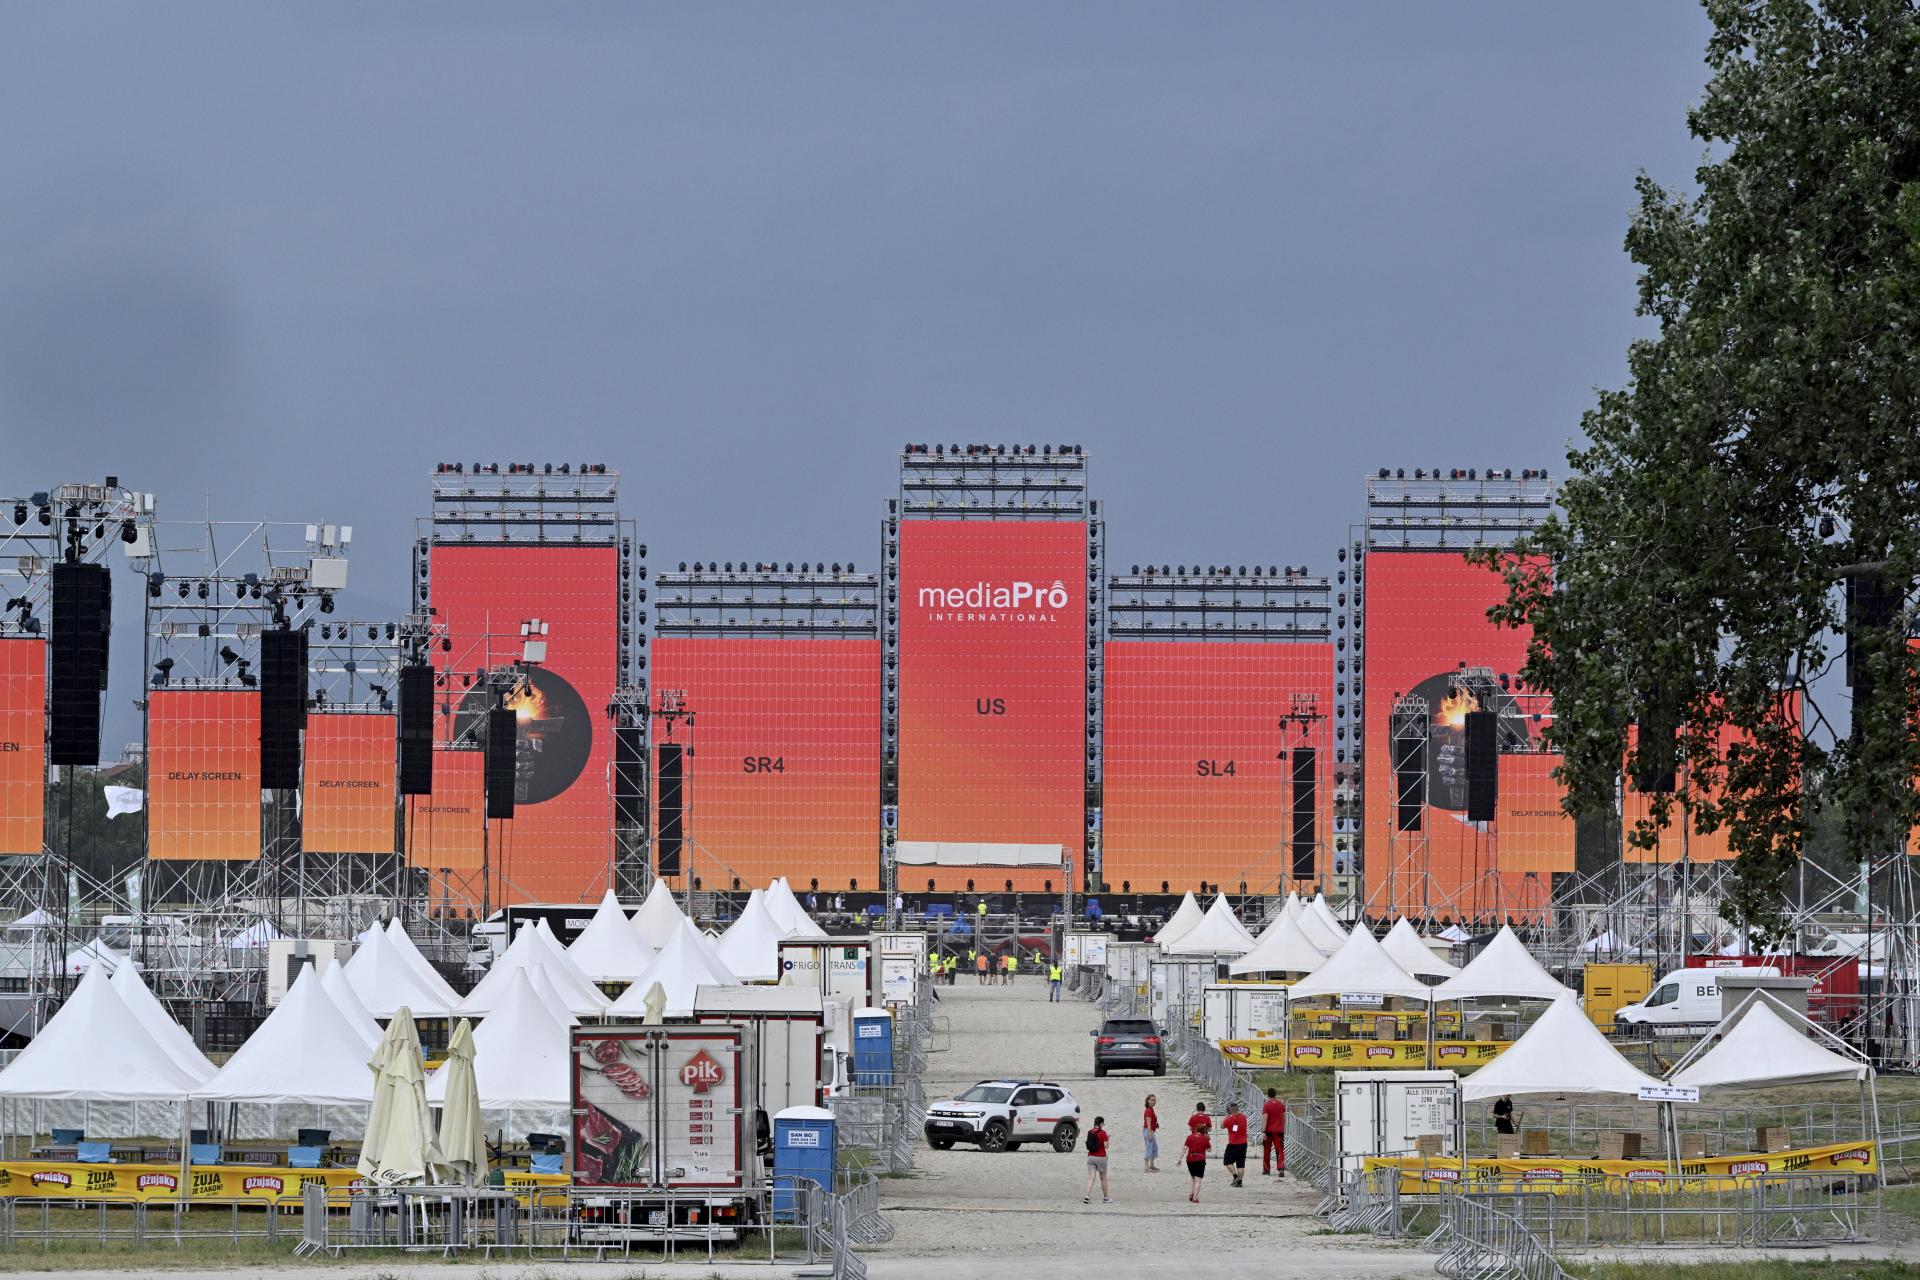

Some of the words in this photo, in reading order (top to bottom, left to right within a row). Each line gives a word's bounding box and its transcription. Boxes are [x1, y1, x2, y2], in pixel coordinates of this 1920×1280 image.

[929, 613, 1057, 622] INTERNATIONAL
[976, 698, 1006, 715] US
[743, 757, 785, 773] SR4
[1197, 760, 1236, 776] SL4
[168, 772, 199, 780] DELAY
[202, 772, 241, 780] SCREEN
[319, 780, 346, 788] DELAY
[793, 961, 820, 970] FRIGO
[829, 961, 856, 970] TRANS
[1261, 1043, 1280, 1054] ŽUJA
[1332, 1044, 1352, 1054] ŽUJA
[1405, 1044, 1424, 1055] ŽUJA
[684, 1061, 718, 1085] pik
[1731, 1161, 1766, 1175] Ožujsko
[88, 1170, 115, 1185] ŽUJA
[140, 1173, 175, 1187] Ožujsko
[193, 1171, 221, 1187] ŽUJA
[246, 1176, 281, 1189] Ožujsko
